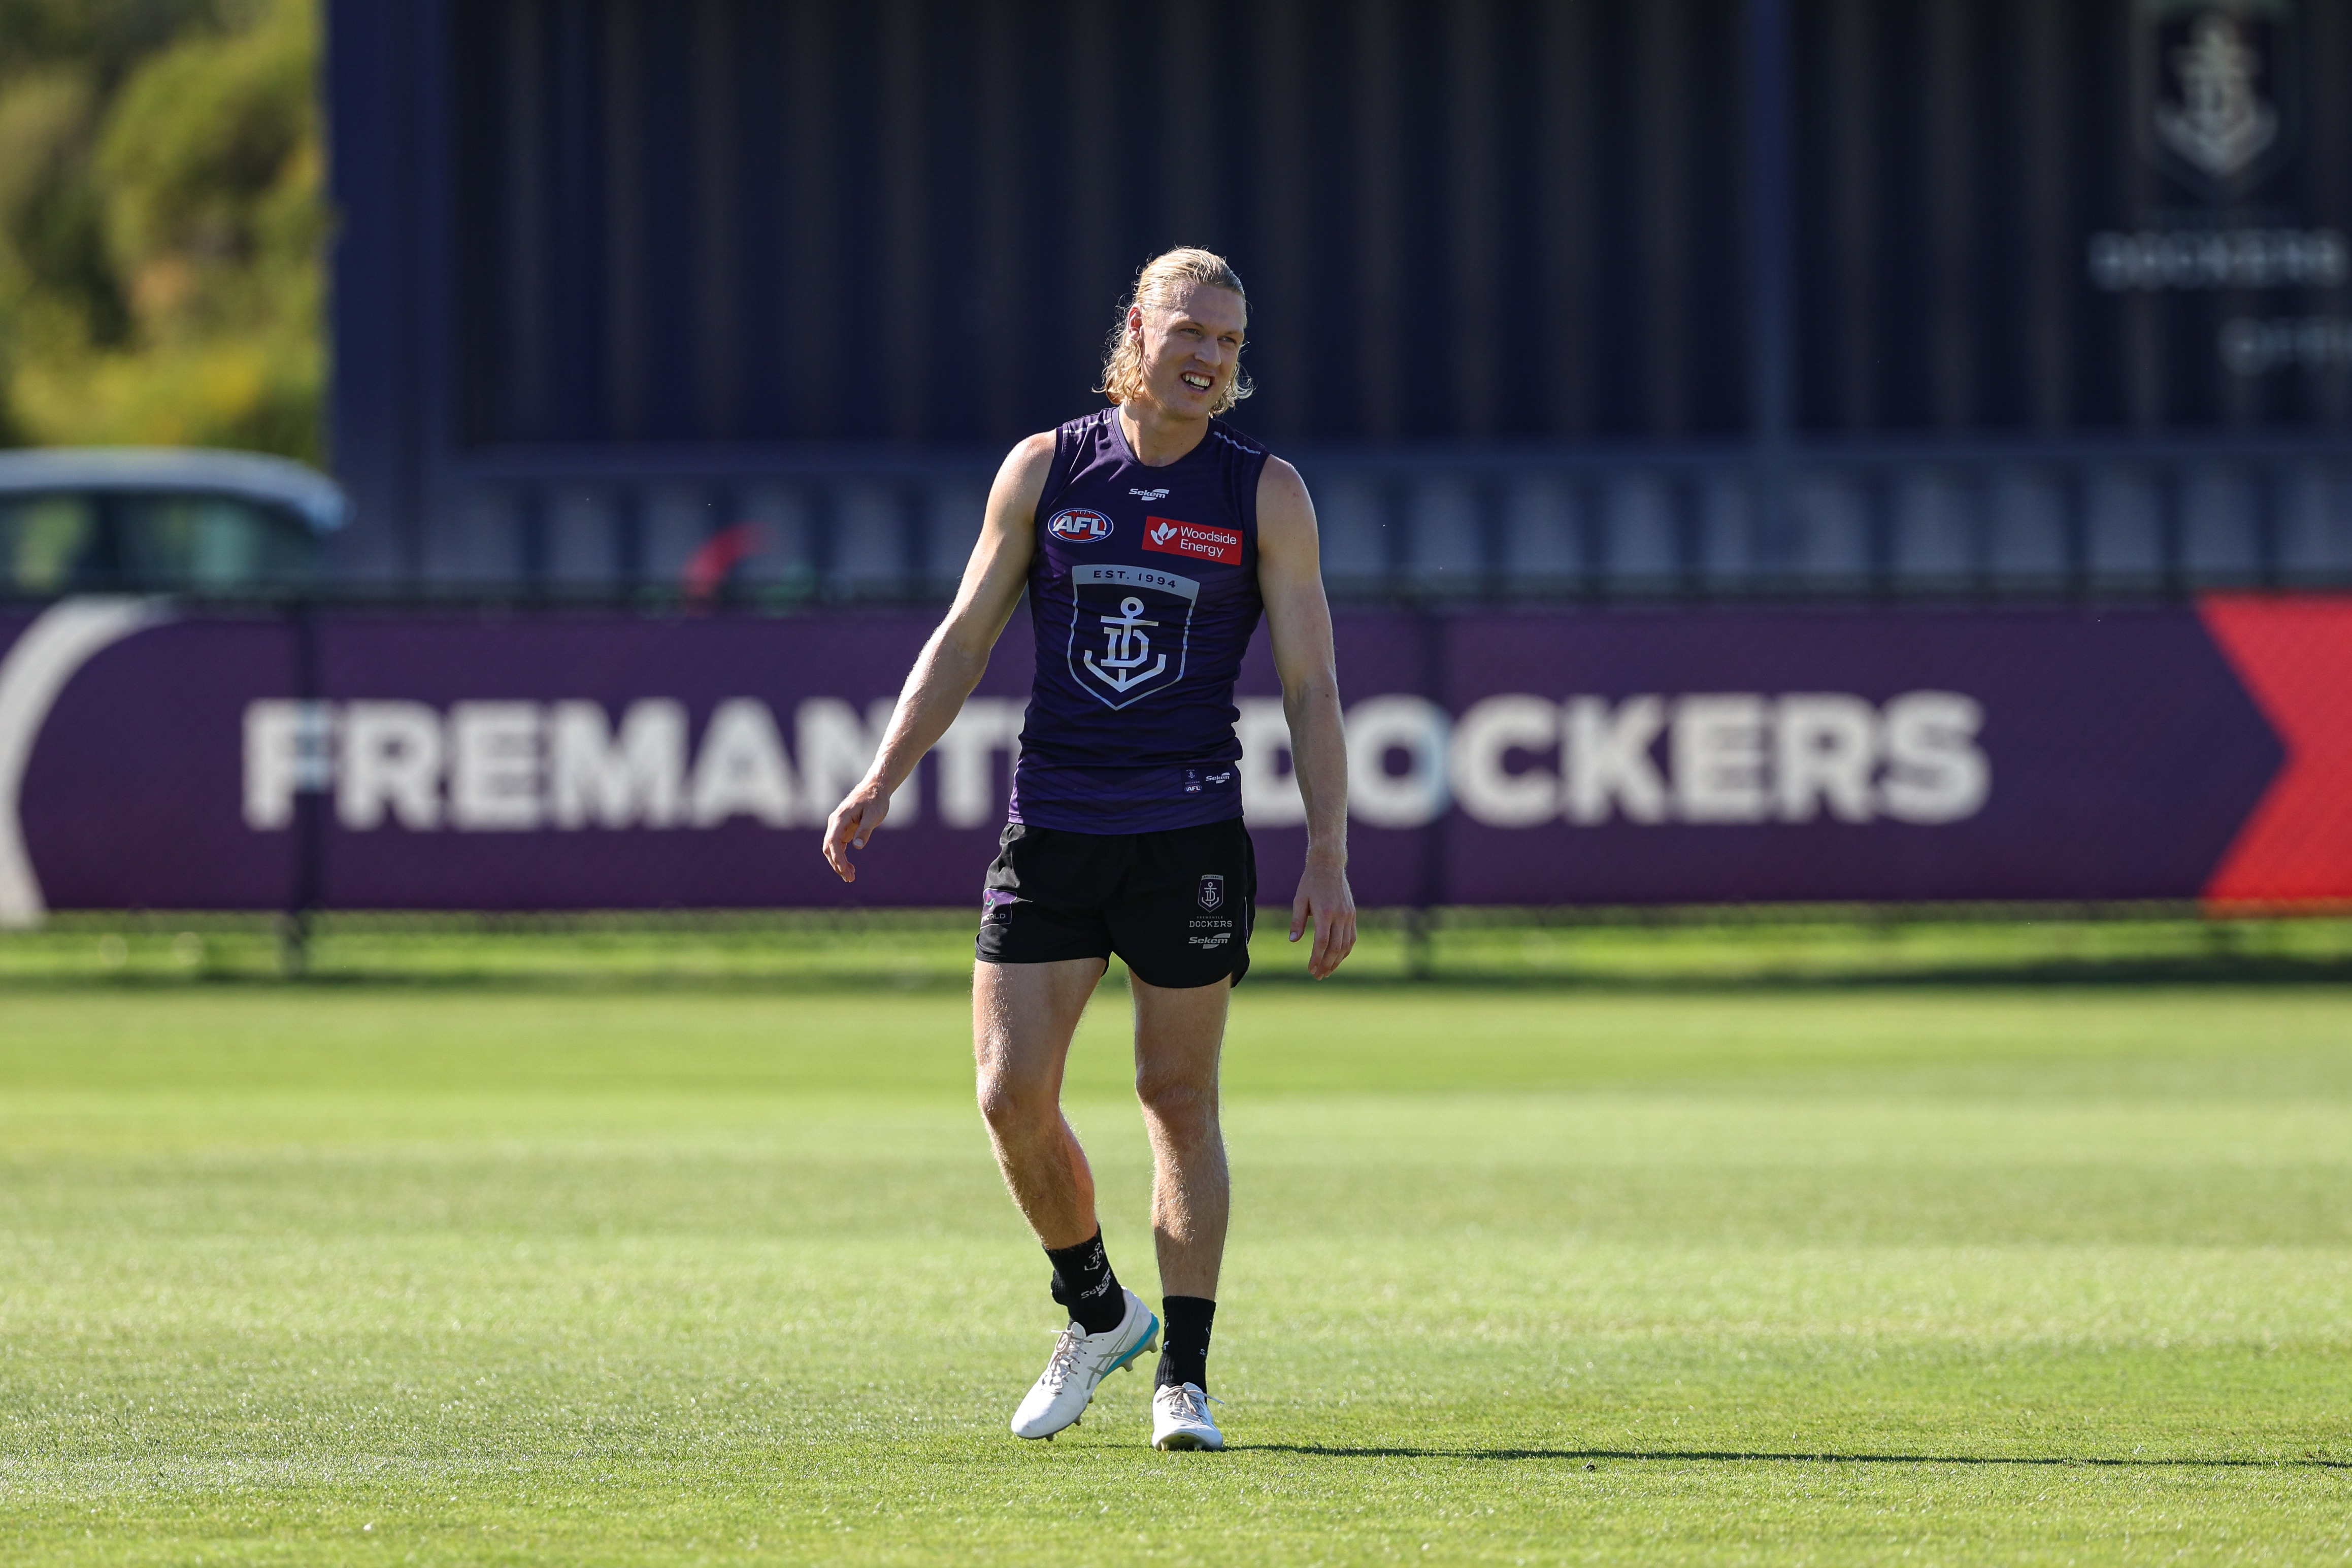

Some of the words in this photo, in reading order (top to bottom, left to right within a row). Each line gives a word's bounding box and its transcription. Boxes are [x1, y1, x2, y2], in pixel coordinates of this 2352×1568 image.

[1129, 488, 1166, 499] Sekem
[1052, 515, 1106, 536] AFL
[1180, 526, 1237, 545] Woodside
[1180, 539, 1224, 557] Energy
[1093, 570, 1130, 579] EST.
[1138, 573, 1176, 588] 1994
[243, 699, 1031, 828] FREMANT
[1234, 693, 1987, 826] DOCKERS
